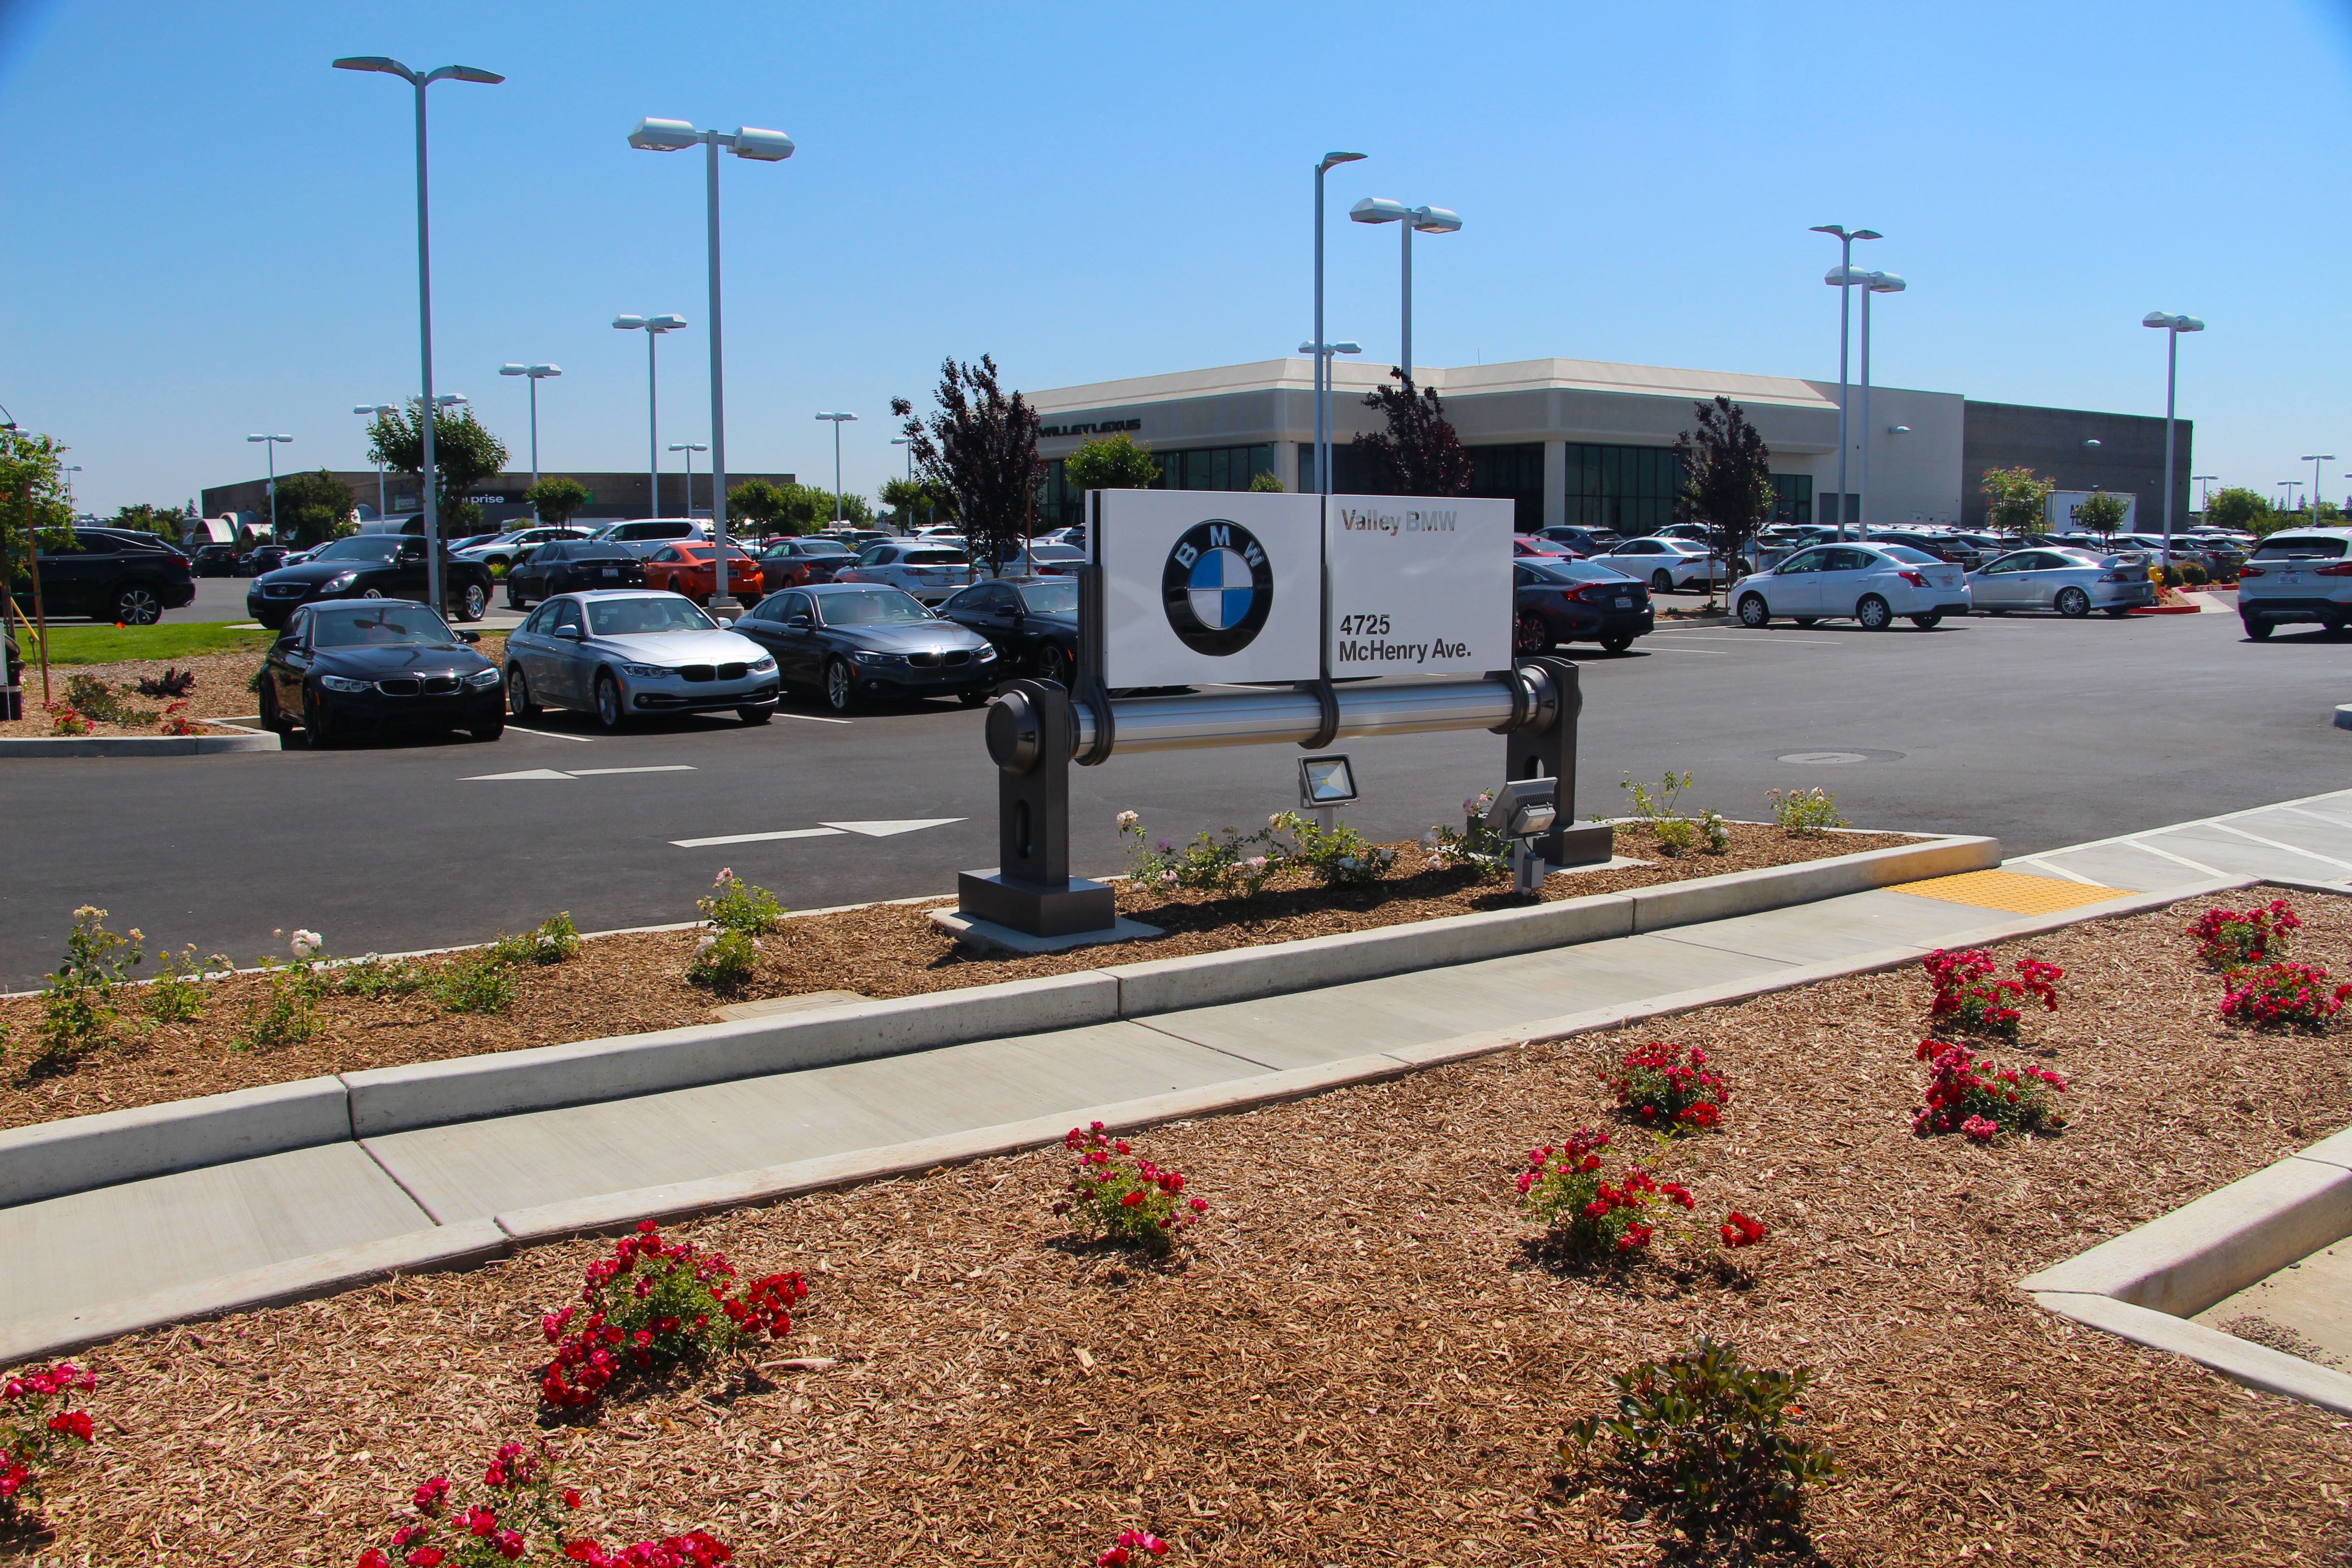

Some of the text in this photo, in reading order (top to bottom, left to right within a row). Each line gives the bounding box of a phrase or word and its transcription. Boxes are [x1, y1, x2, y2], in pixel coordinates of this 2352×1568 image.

[1341, 509, 1458, 536] Valley BMW
[1174, 525, 1265, 569] BMW
[1340, 614, 1390, 635] 4725
[1339, 638, 1471, 664] McHenry Ave.
